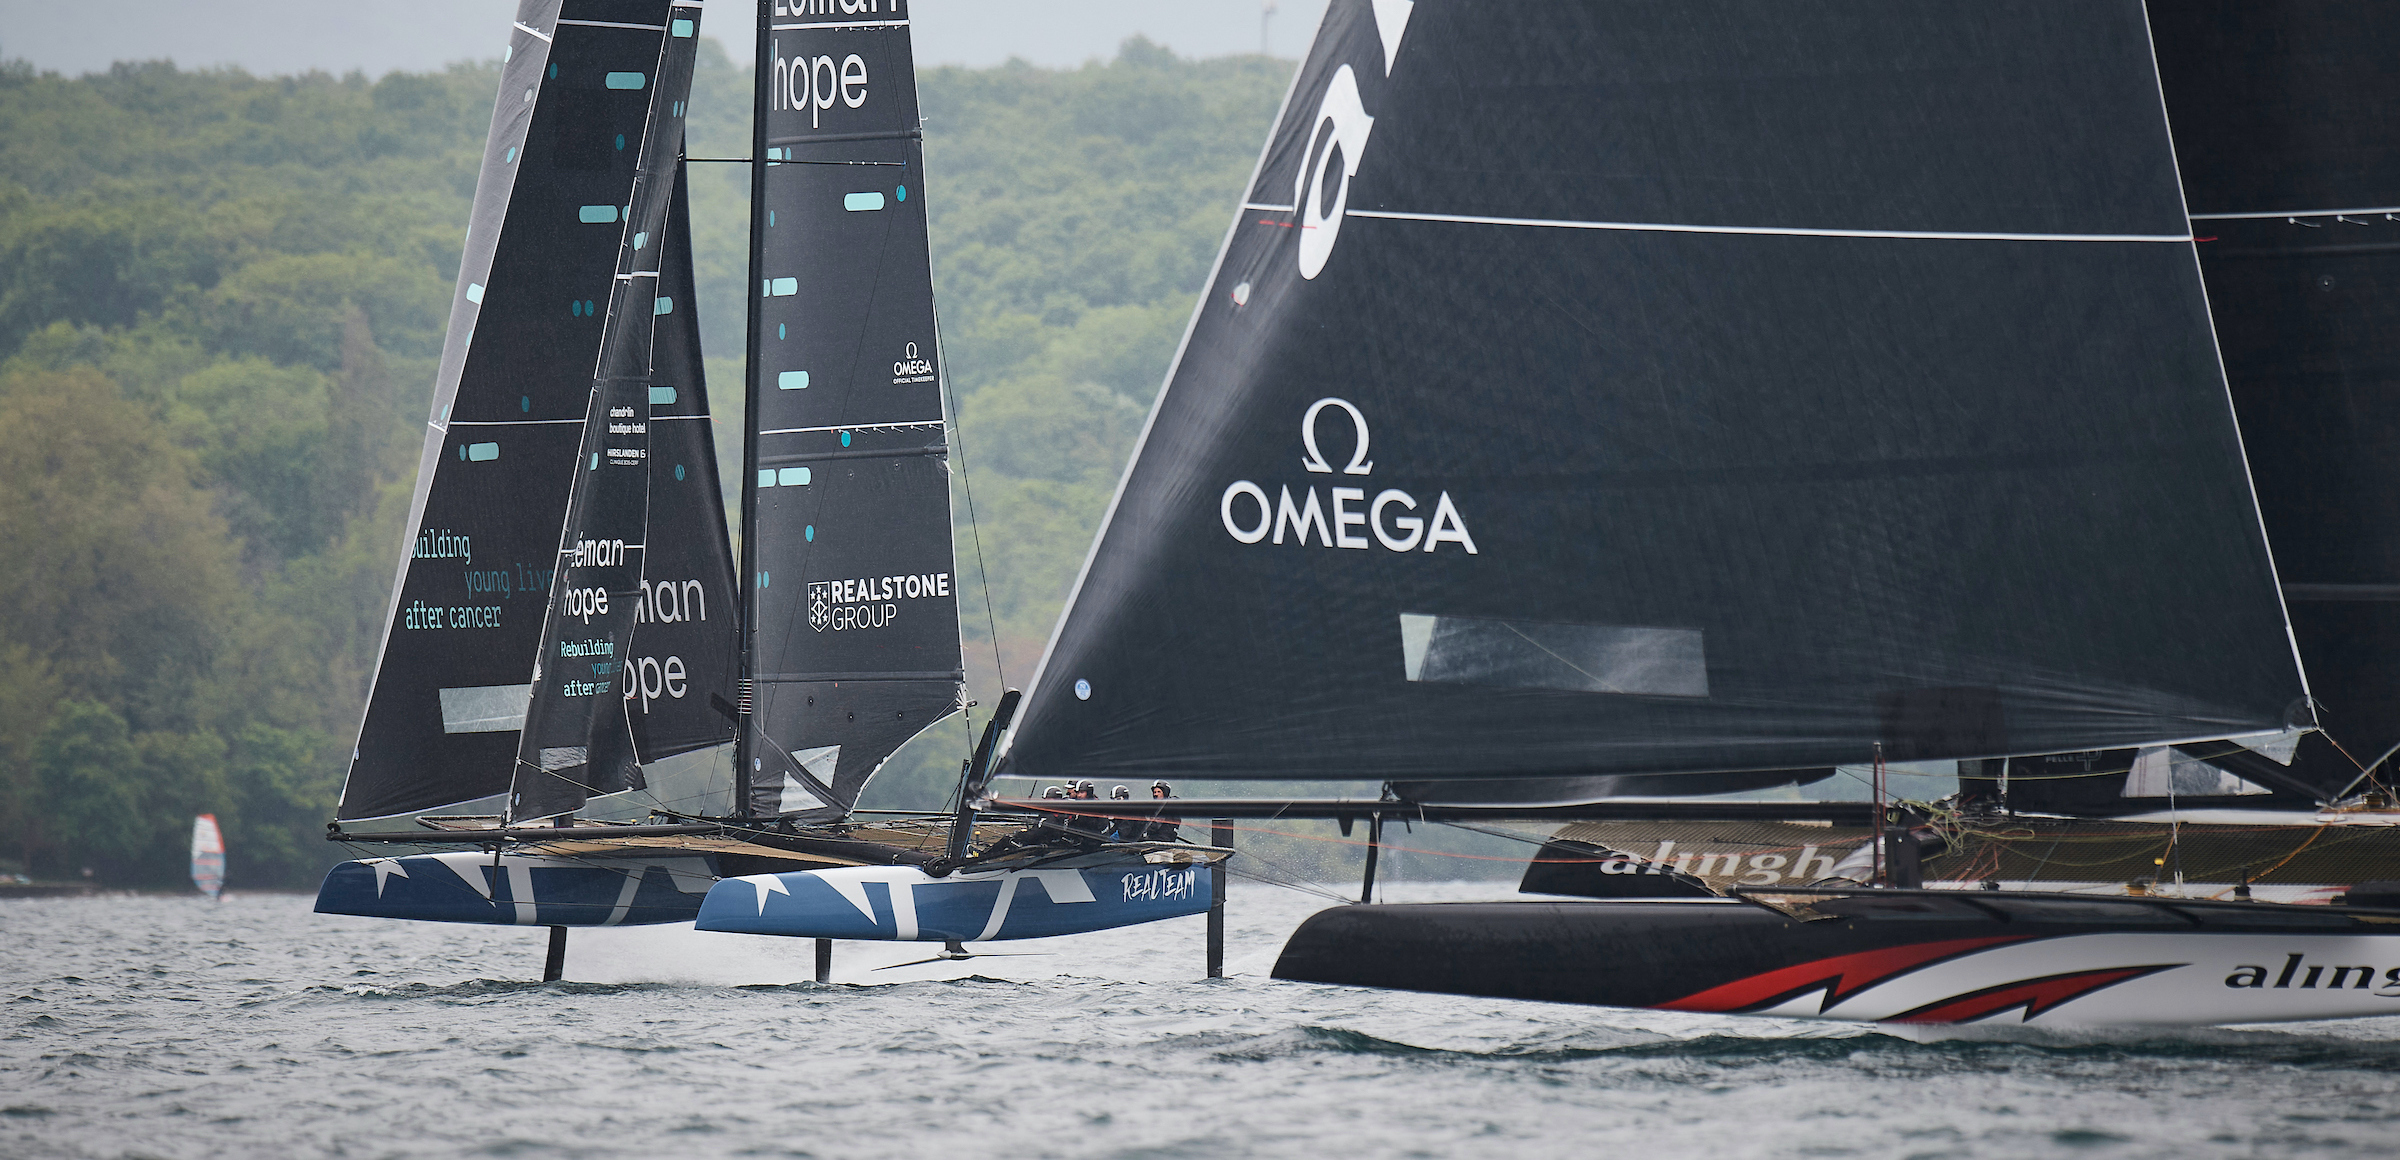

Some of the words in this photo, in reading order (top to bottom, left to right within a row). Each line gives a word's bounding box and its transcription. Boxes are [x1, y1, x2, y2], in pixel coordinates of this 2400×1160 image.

[773, 38, 868, 129] hope
[893, 359, 933, 376] OMEGA
[1220, 479, 1479, 555] OMEGA
[464, 569, 510, 600] young
[831, 572, 950, 604] REALSTONE
[405, 600, 444, 630] after
[449, 605, 502, 629] cancer
[563, 580, 609, 625] hope
[831, 603, 897, 631] GROUP
[560, 639, 614, 659] Rebuilding
[563, 679, 595, 697] after
